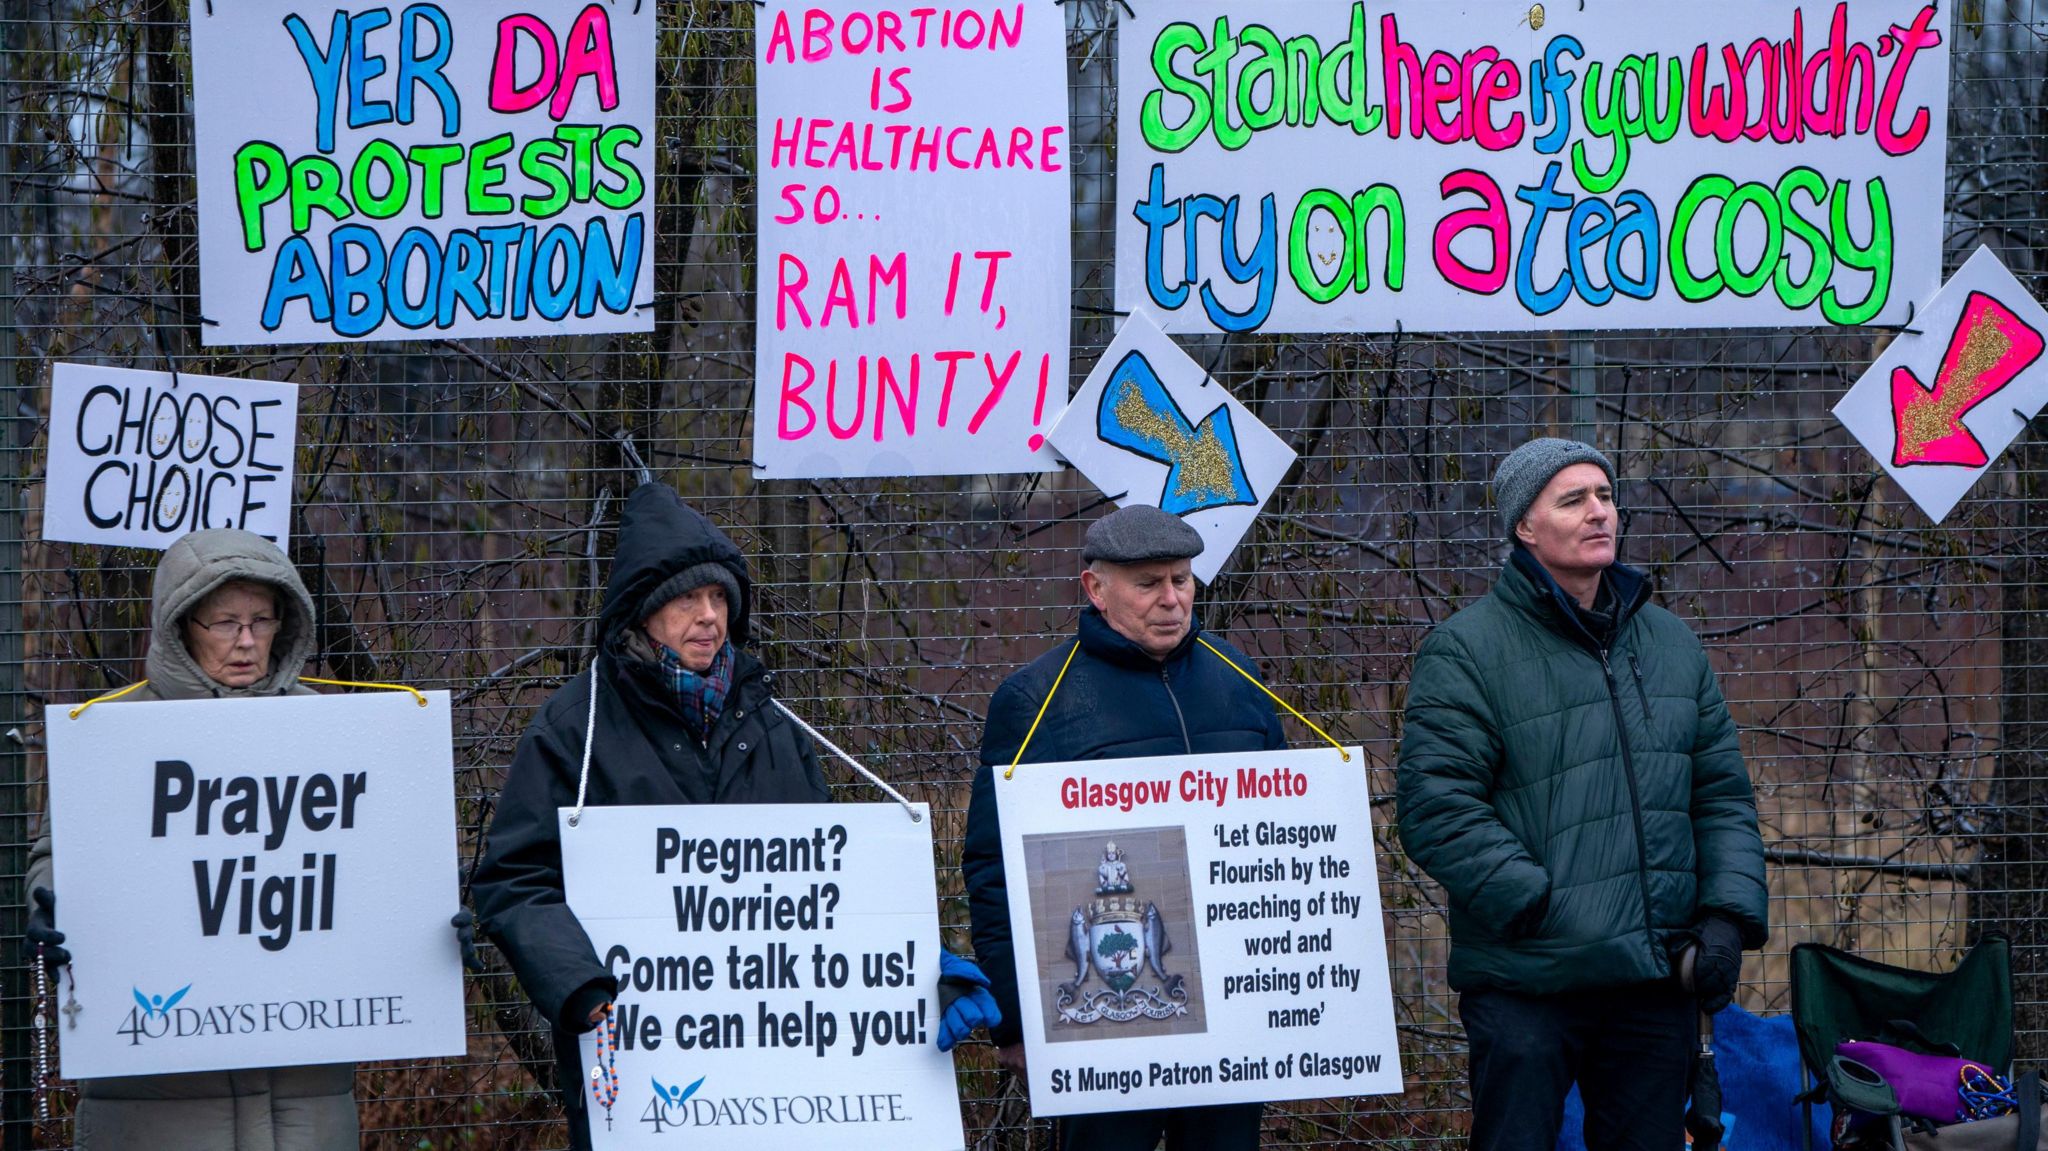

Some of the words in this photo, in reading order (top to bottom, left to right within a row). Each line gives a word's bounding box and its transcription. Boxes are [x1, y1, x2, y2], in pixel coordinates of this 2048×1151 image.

[766, 3, 1024, 63] ABORTION
[283, 2, 460, 154] YER
[489, 3, 619, 121] DA
[870, 67, 912, 113] IS
[1140, 1, 1382, 153] Stand
[1381, 13, 1525, 151] here
[1572, 52, 1684, 193] you
[1689, 2, 1941, 157] wouldn't
[771, 117, 1064, 172] HEALTHCARE
[234, 124, 645, 252] PROTESTS
[774, 184, 880, 225] SO...
[260, 212, 644, 337] ABORTION
[1133, 162, 1278, 333] try
[1288, 183, 1405, 304] on
[1433, 169, 1510, 295] a
[1515, 161, 1660, 316] tea
[1668, 166, 1894, 326] cosy
[776, 252, 906, 331] RAM
[945, 251, 1012, 330] IT,
[76, 384, 284, 471] CHOOSE
[778, 350, 1049, 452] BUNTY!
[84, 460, 277, 542] CHOICE
[151, 760, 367, 851] Prayer
[1061, 777, 1170, 812] Glasgow
[1180, 769, 1228, 806] City
[1237, 767, 1307, 798] Motto
[656, 824, 847, 883] Pregnant?
[1214, 824, 1249, 848] ‘Let
[1256, 821, 1336, 848] Glasgow
[1210, 858, 1285, 884] Flourish
[1292, 858, 1312, 884] by
[1320, 855, 1349, 879] the
[192, 853, 337, 952] Vigil
[673, 883, 840, 932] Worried?
[1207, 895, 1300, 927] preaching
[1308, 893, 1325, 916] of
[1331, 892, 1360, 918] thy
[604, 944, 713, 992] Come
[727, 943, 799, 989] talk
[812, 943, 849, 988] to
[862, 940, 916, 988] us!
[1245, 931, 1291, 956] word
[1298, 928, 1331, 953] and
[1224, 968, 1300, 999] praising
[1307, 966, 1325, 988] of
[1331, 964, 1360, 992] thy
[676, 1008, 744, 1050] can
[757, 1000, 837, 1057] help
[850, 998, 927, 1057] you!
[1268, 1002, 1325, 1028] name’
[1051, 1069, 1071, 1094] St
[1079, 1066, 1143, 1094] Mungo
[1149, 1061, 1213, 1087] Patron
[1219, 1057, 1268, 1082] Saint
[1275, 1055, 1293, 1077] of
[1299, 1052, 1382, 1081] Glasgow
